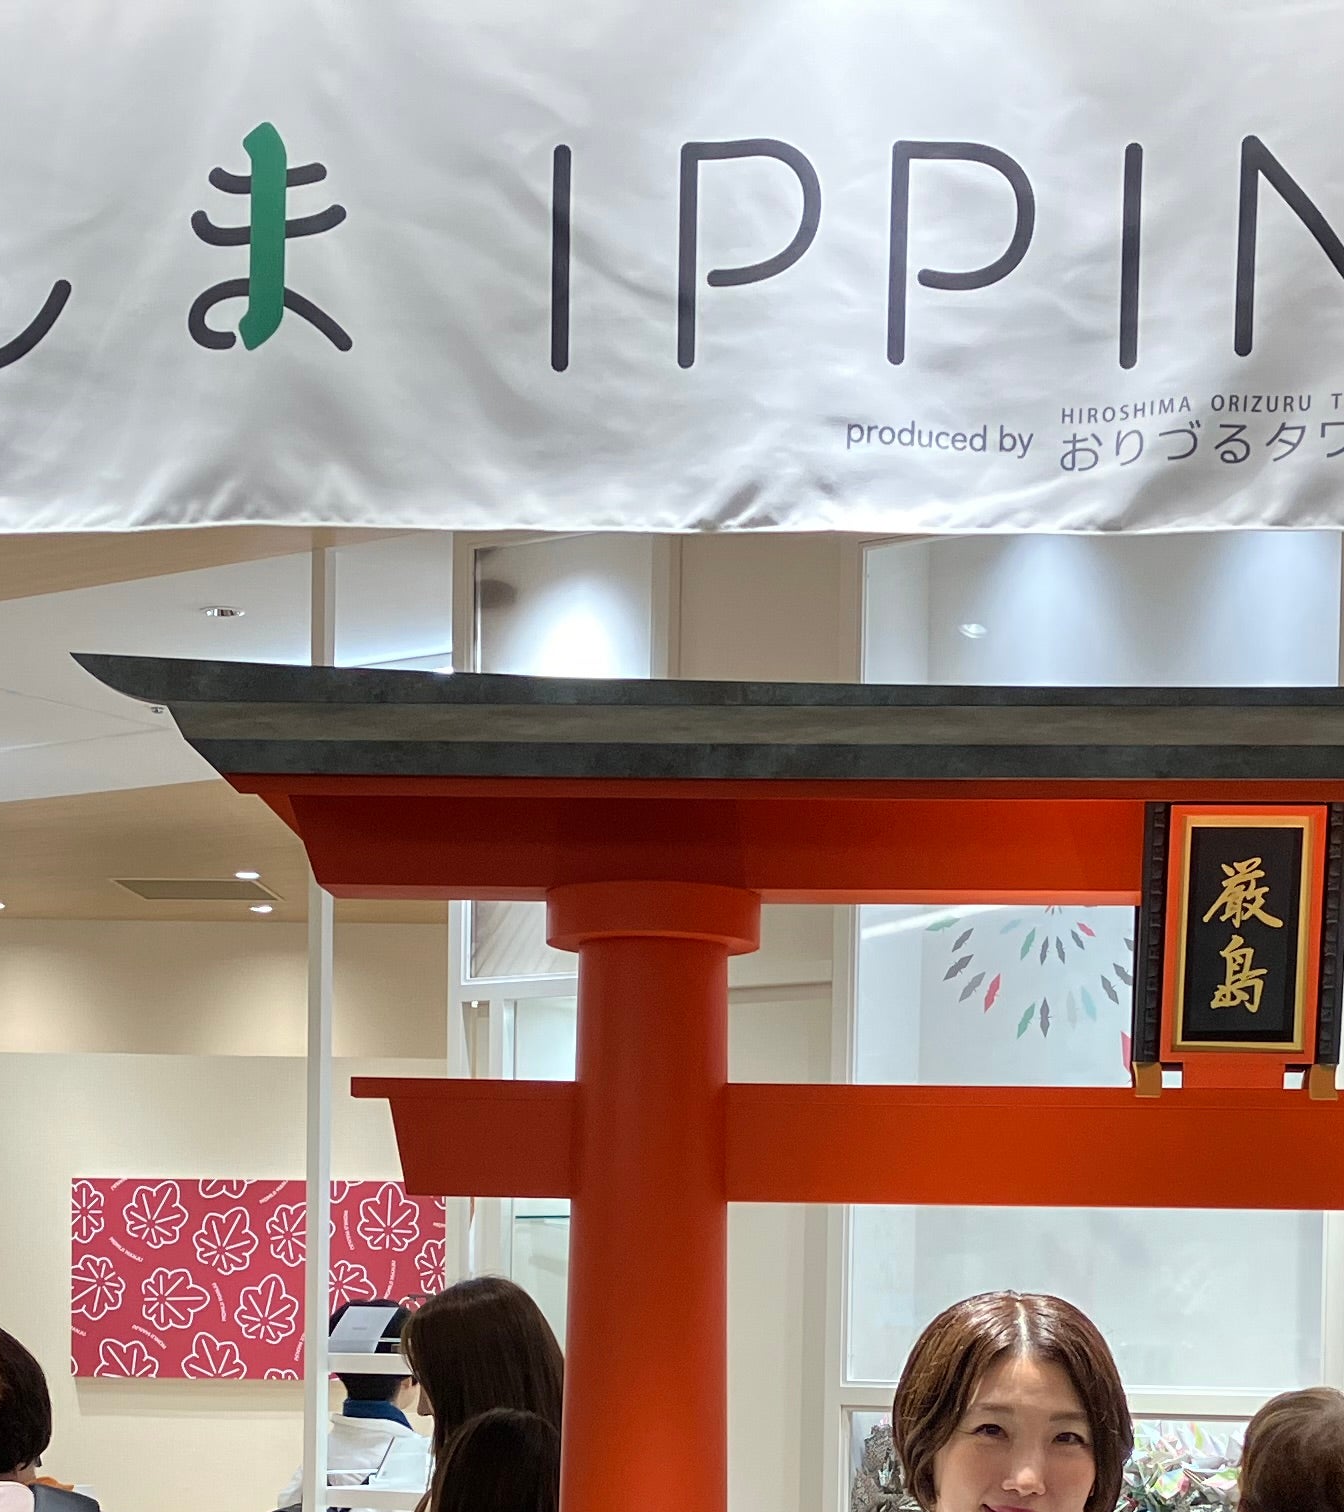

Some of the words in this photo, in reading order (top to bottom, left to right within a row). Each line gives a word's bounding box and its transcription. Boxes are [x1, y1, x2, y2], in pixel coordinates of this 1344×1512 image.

[1061, 396, 1192, 425] HIROSHIMA
[1210, 394, 1312, 413] ORIZURU
[846, 420, 987, 451] produced
[998, 424, 1034, 459] by
